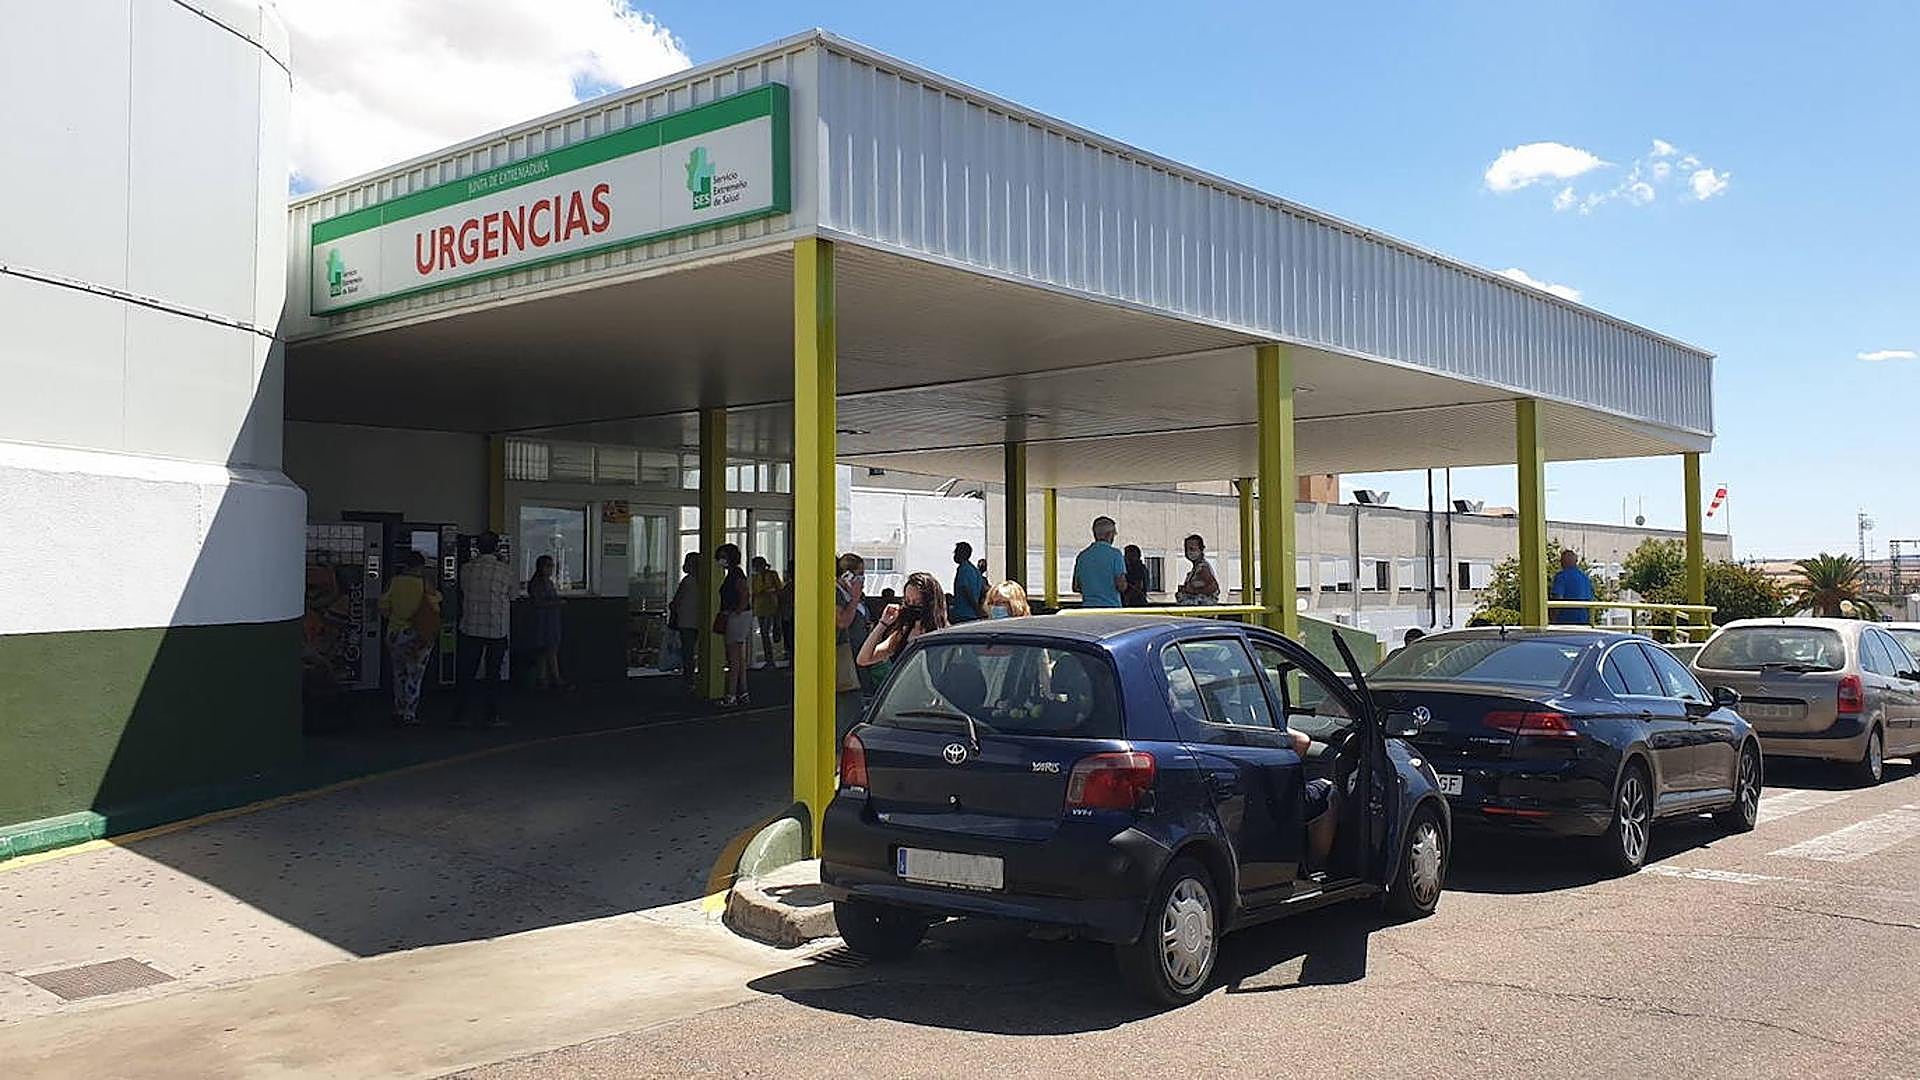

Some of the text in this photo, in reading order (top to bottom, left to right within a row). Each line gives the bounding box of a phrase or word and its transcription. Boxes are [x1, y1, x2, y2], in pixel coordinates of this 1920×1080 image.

[694, 193, 711, 208] SES
[415, 183, 611, 275] URGENCIAS
[1032, 761, 1061, 774] YARIS
